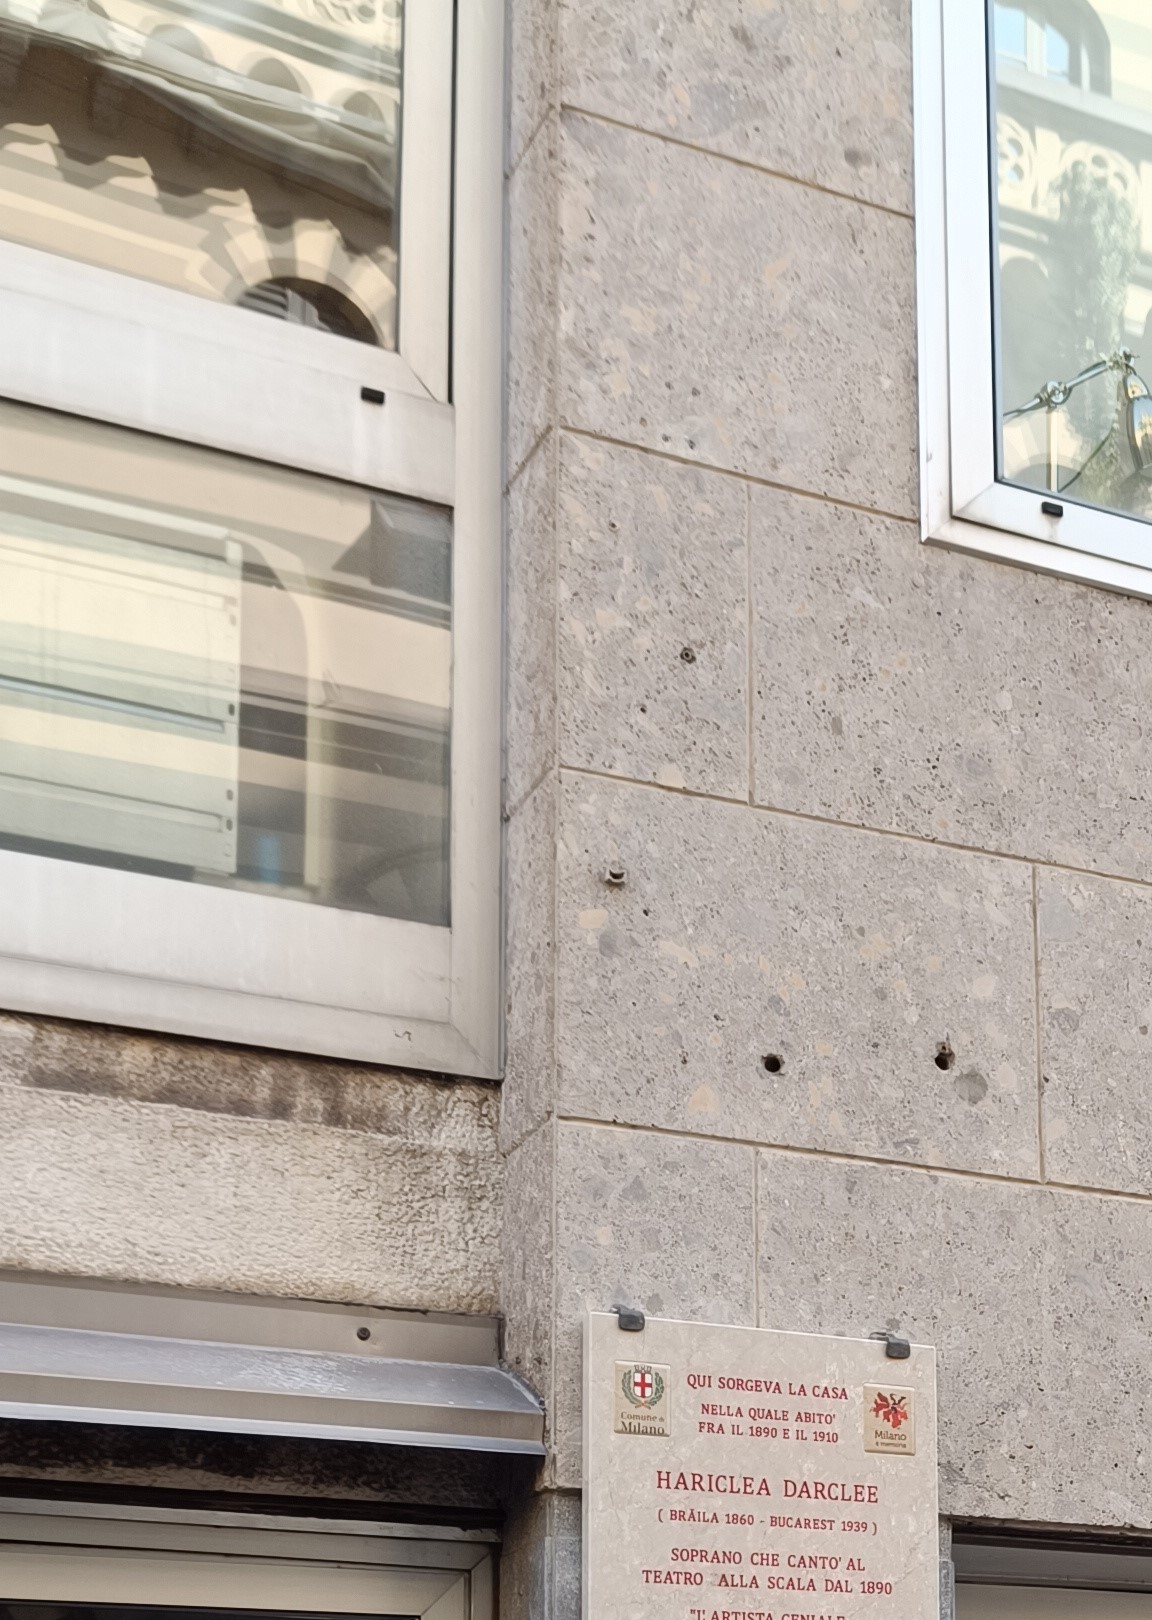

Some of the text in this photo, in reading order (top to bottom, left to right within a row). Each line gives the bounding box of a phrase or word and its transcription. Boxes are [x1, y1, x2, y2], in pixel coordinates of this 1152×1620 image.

[686, 1373, 849, 1402] QUI SORGEVA LA CASA
[620, 1411, 657, 1422] Comune
[700, 1402, 836, 1426] NELLA QUALE ABITO'
[620, 1420, 665, 1435] Milano
[697, 1420, 839, 1445] FRA IL 1890 E IL 1910
[874, 1430, 907, 1441] Milano
[656, 1470, 879, 1505] HARICLEA DARCLEE
[724, 1513, 755, 1526] 1860
[769, 1515, 836, 1531] BUCAREST
[841, 1520, 869, 1533] 1939
[670, 1547, 866, 1573] SOPRANO CHE CANTO' AL
[641, 1569, 894, 1596] TEATRO ALLA SCALA DAL 1890
